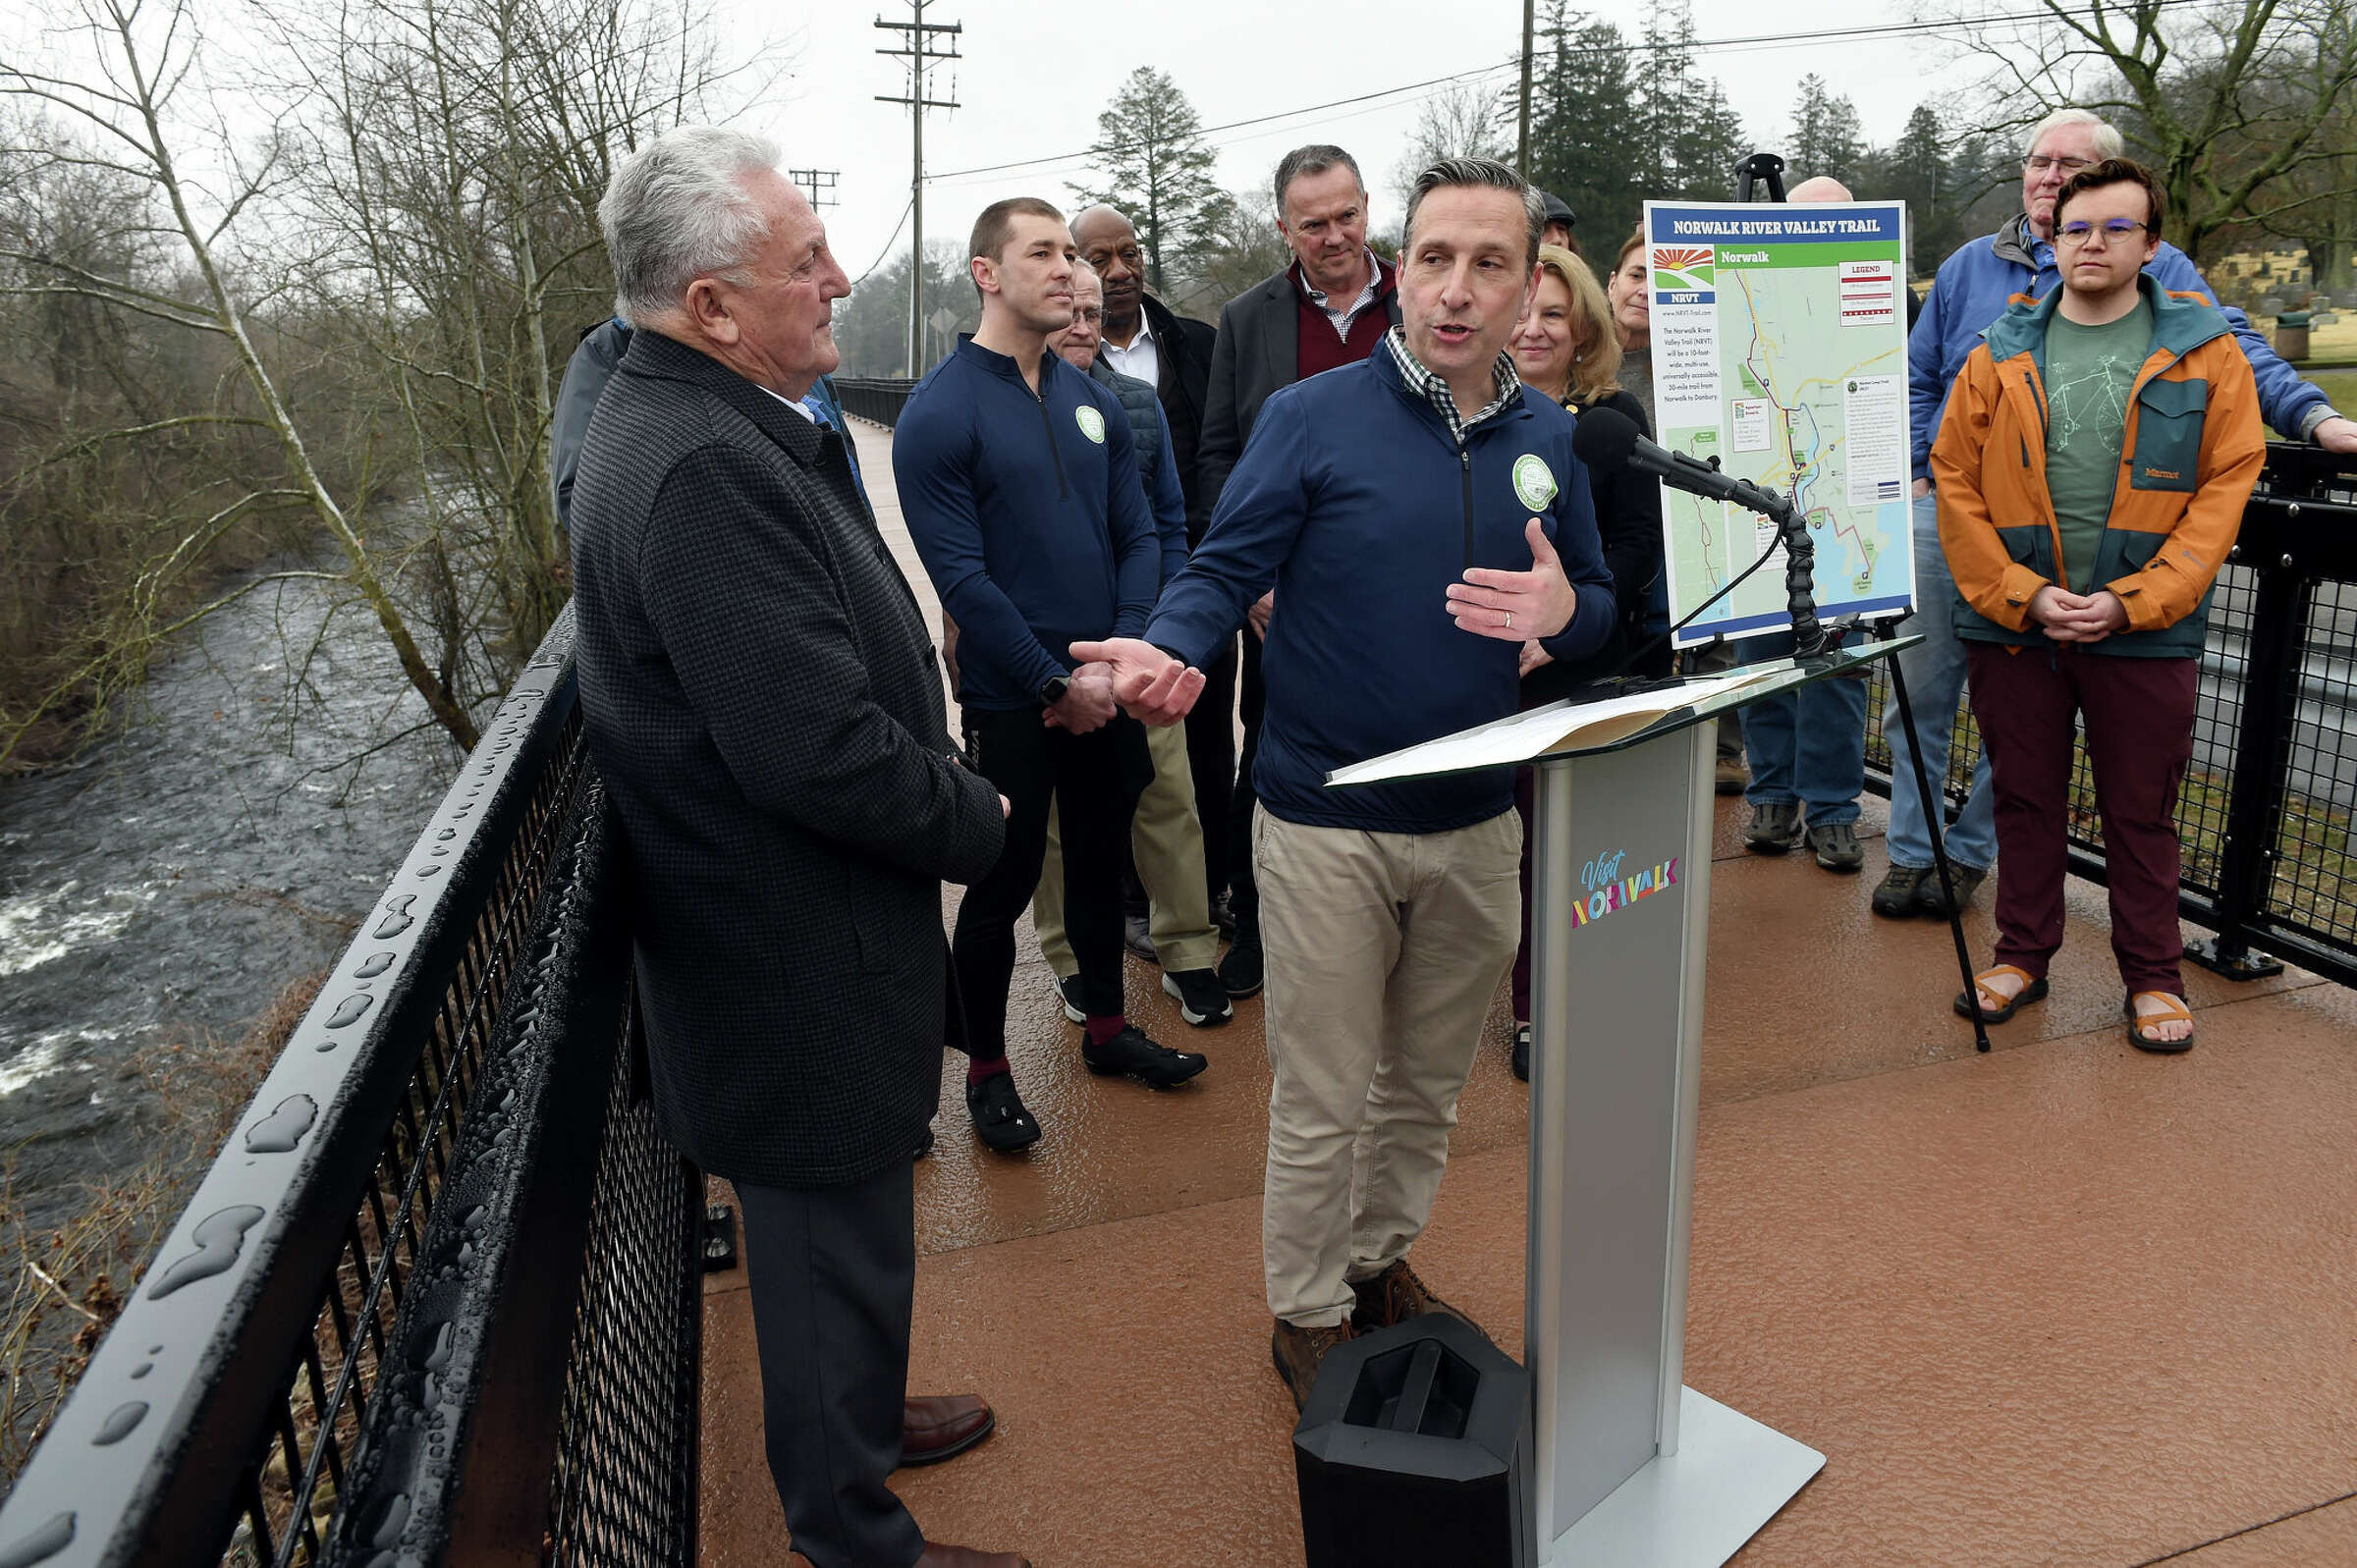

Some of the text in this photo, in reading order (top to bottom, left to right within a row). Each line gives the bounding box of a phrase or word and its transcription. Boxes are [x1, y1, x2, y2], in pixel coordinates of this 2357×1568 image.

[1673, 219, 1881, 235] NORWALK RIVER VALLEY TRAIL
[1721, 251, 1769, 263] Norwalk
[1851, 265, 1881, 274] LEGEND
[1672, 294, 1700, 303] NRVT
[1664, 338, 1680, 347] Valley
[1700, 381, 1714, 390] from
[1581, 849, 1625, 891] Visit
[1572, 857, 1677, 929] NORWALK
